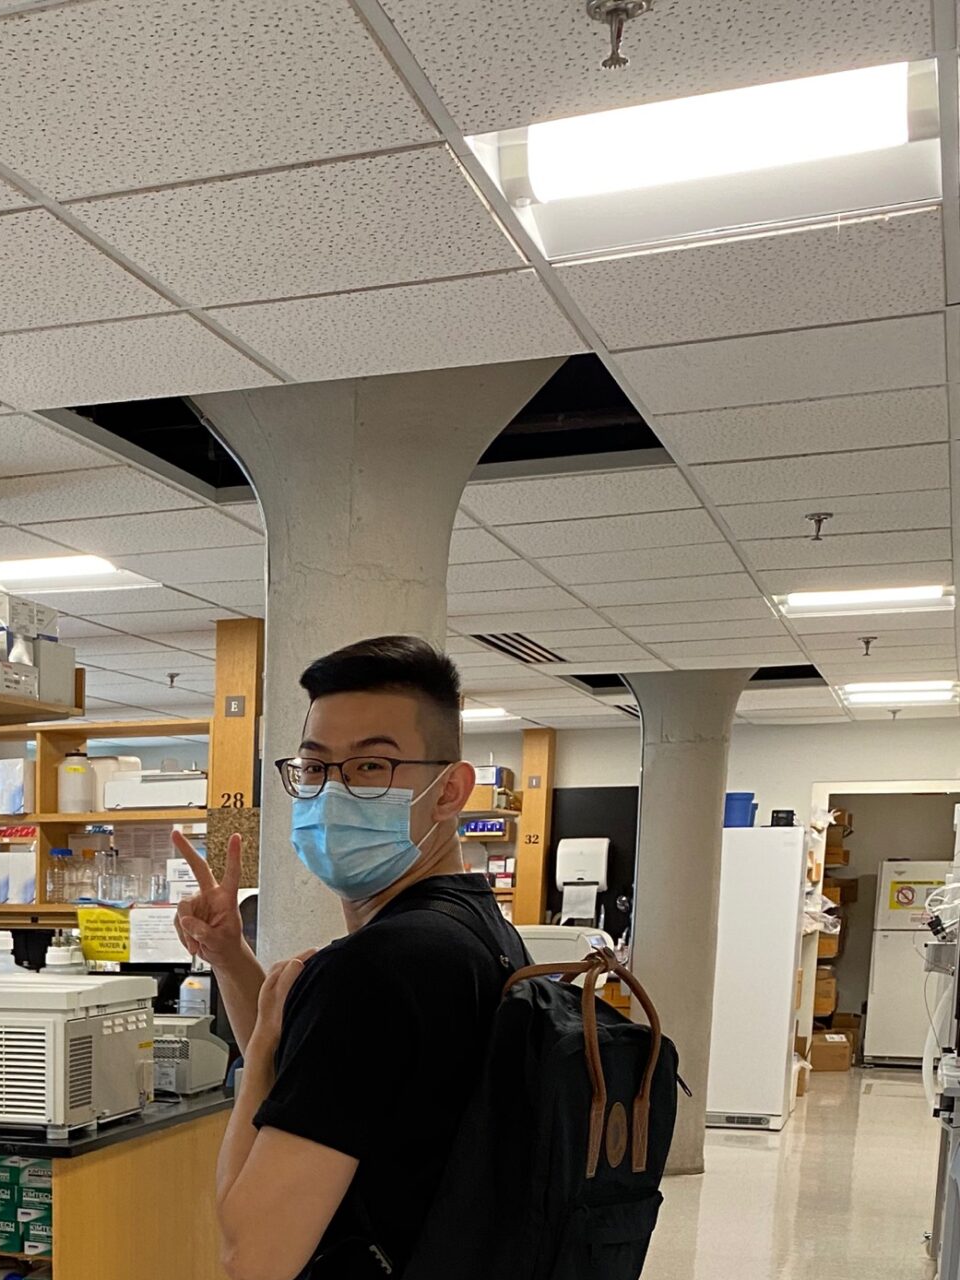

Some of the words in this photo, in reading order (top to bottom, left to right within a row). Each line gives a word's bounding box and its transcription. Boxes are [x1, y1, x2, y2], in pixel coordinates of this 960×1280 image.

[230, 701, 239, 712] E
[220, 792, 245, 809] 28
[524, 834, 539, 845] 32
[23, 1192, 52, 1201] KIMTEC
